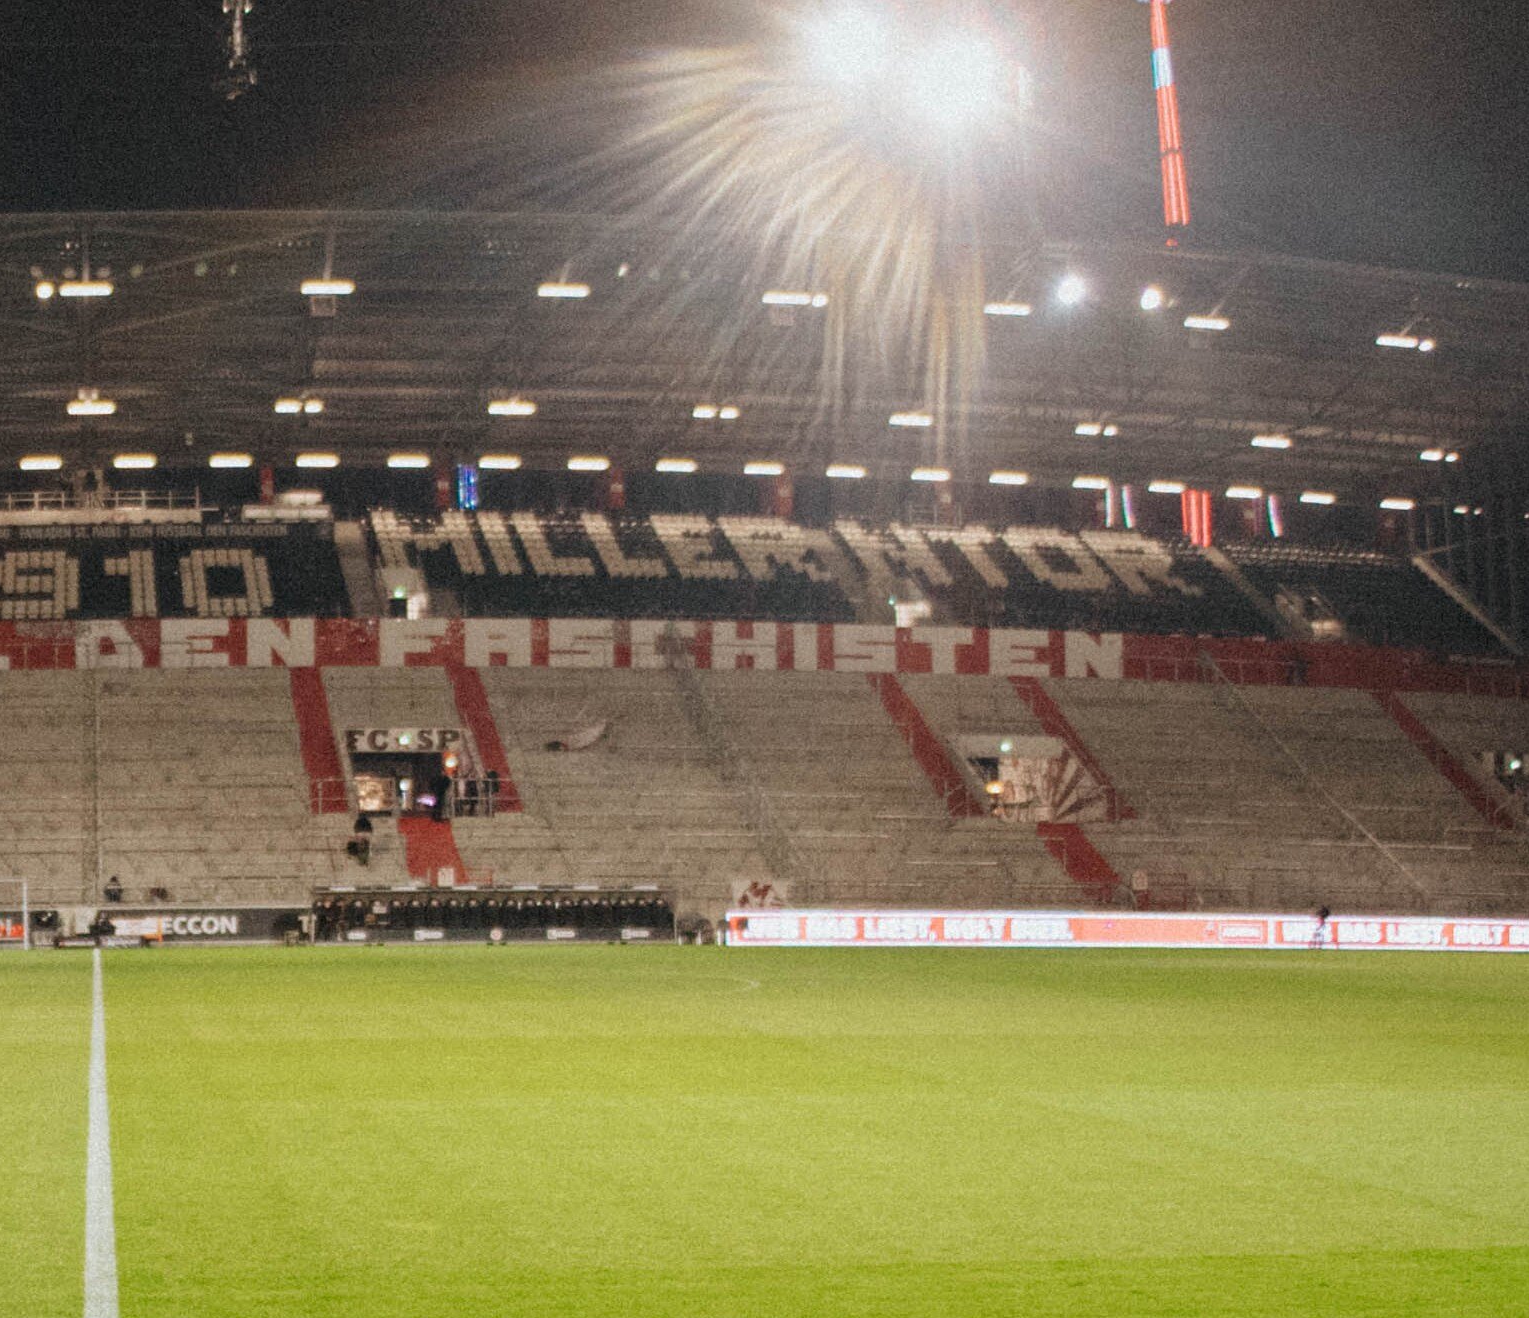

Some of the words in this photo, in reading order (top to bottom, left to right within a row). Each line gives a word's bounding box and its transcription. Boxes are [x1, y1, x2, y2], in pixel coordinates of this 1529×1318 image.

[368, 509, 1206, 598] MILLERNTOR
[73, 617, 318, 671] DEN
[378, 616, 1124, 680] FASCHISTEN
[417, 729, 461, 751] SP
